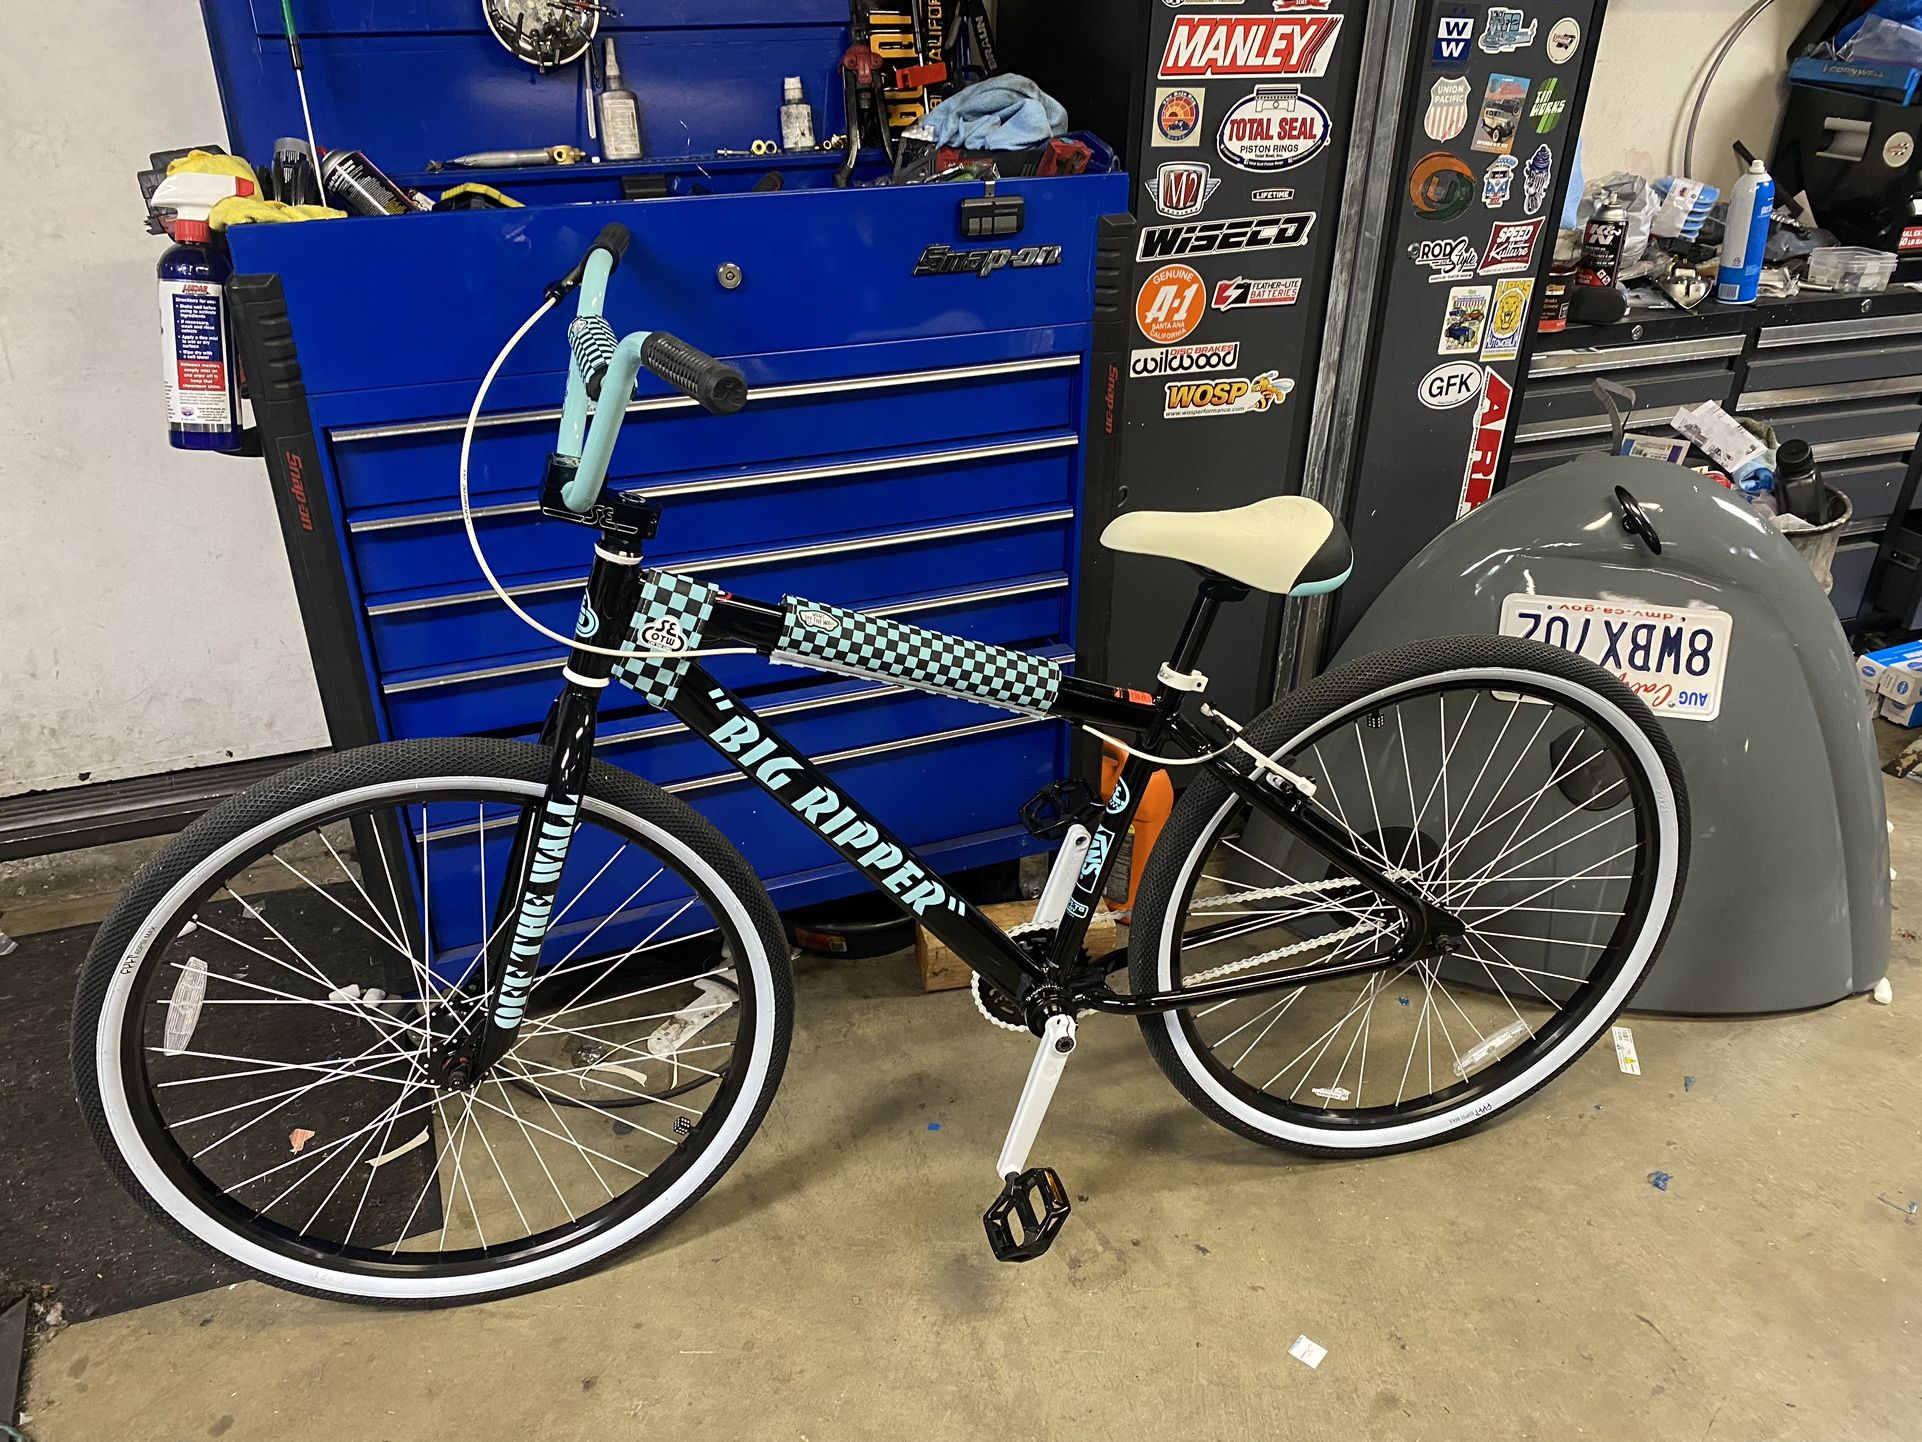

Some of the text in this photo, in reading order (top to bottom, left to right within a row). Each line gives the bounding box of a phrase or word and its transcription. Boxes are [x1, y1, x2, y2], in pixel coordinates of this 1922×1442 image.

[926, 0, 942, 68] ALIFO
[1445, 21, 1469, 37] W
[975, 15, 998, 71] BRAUN
[1165, 23, 1321, 70] MANLEY
[1441, 41, 1465, 58] W
[1437, 85, 1464, 95] UNION
[1534, 90, 1553, 104] TIN
[1434, 95, 1464, 104] PACIFIC
[1529, 99, 1567, 117] WORKS
[1228, 117, 1318, 141] TOTAL SEAL
[1240, 145, 1272, 154] PISTON
[1273, 144, 1299, 153] RINGS
[1166, 171, 1198, 208] M2
[1256, 191, 1289, 199] LIFETIME
[1497, 225, 1534, 244] SPEED
[1421, 242, 1453, 260] ROD
[913, 244, 1062, 277] Snap-on
[1153, 270, 1194, 284] GENUINE
[1252, 280, 1299, 290] FEATHER-LITE
[1251, 289, 1297, 299] BATTERIES
[1145, 283, 1199, 323] A-1
[1150, 328, 1187, 340] CALIFORNIA
[1152, 321, 1185, 331] SANTA ANA
[1170, 344, 1234, 356] DISC BRAKES
[1132, 344, 1239, 375] wilwood
[1428, 372, 1474, 398] GFK
[1167, 382, 1248, 409] WOSP
[1559, 603, 1675, 621] dmv.ca.gov
[655, 619, 677, 637] SE
[651, 632, 675, 646] OTW
[1678, 690, 1709, 707] AUG
